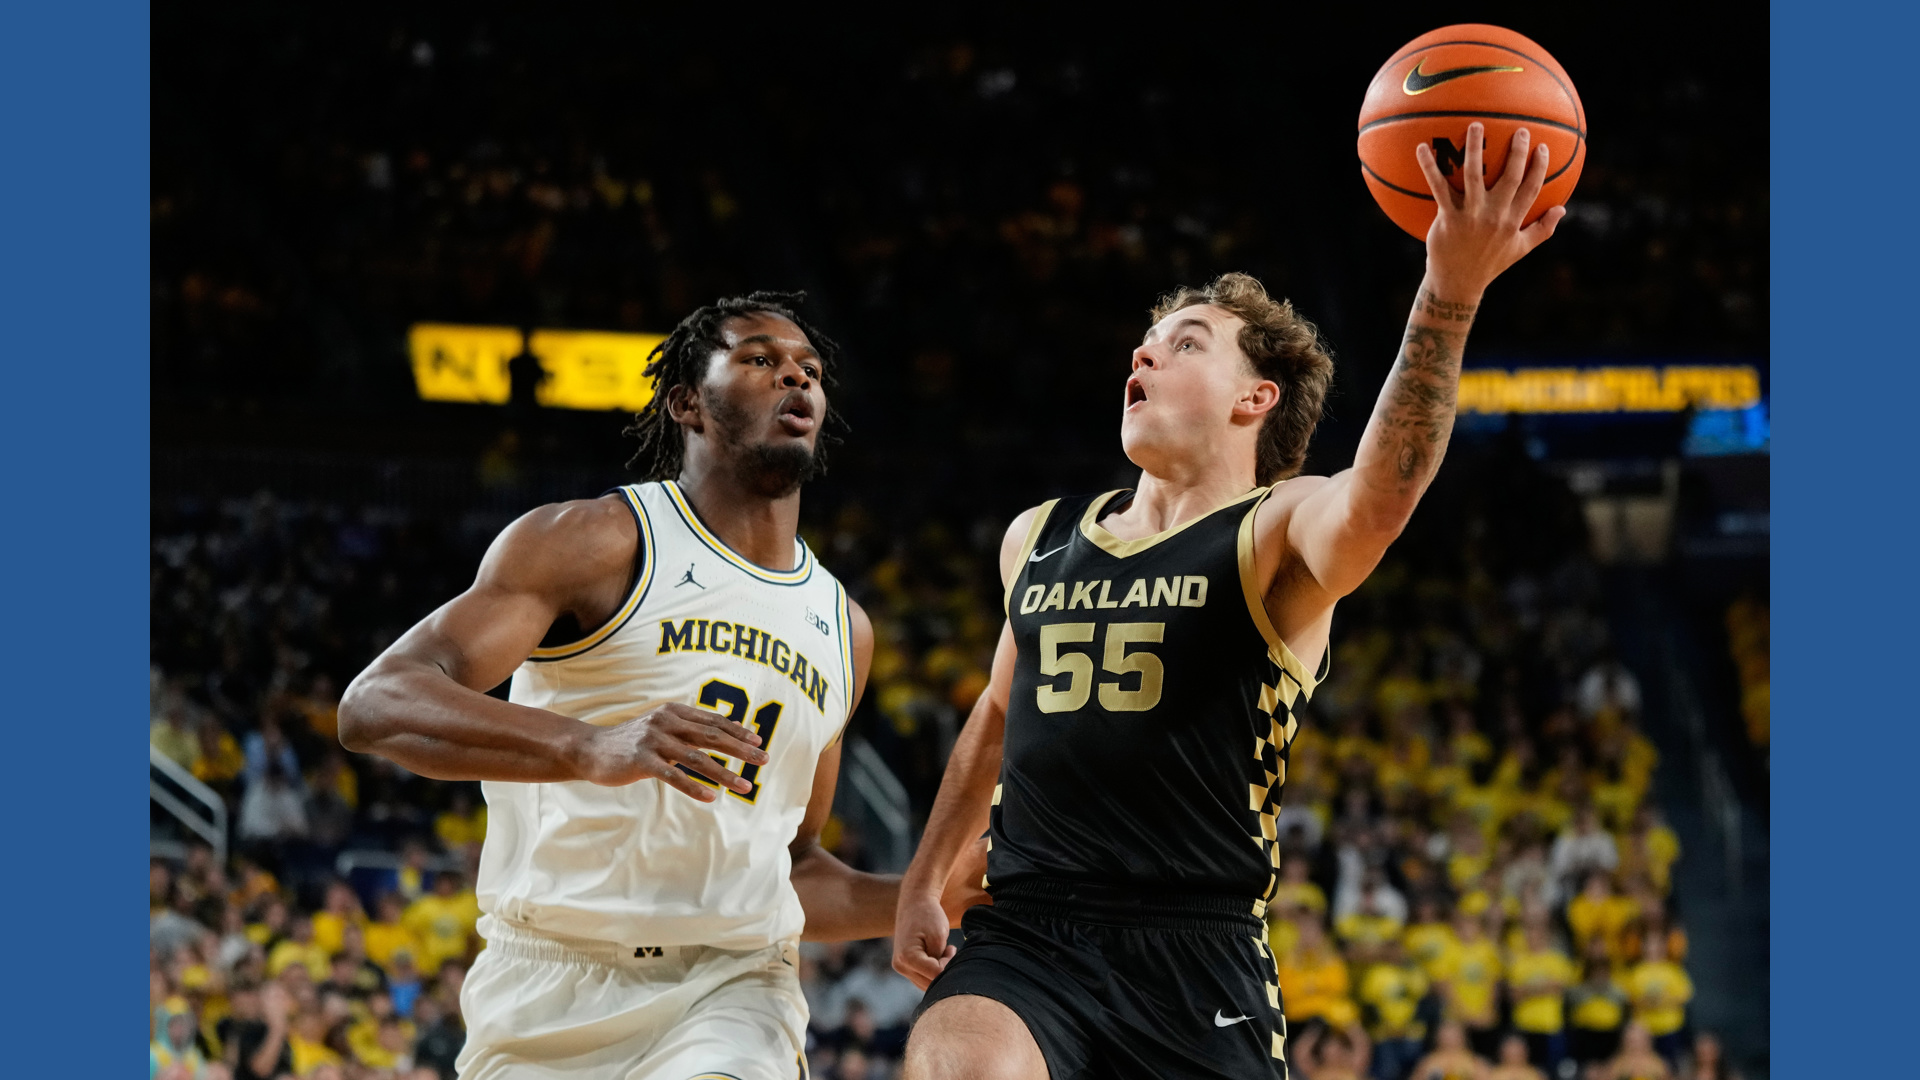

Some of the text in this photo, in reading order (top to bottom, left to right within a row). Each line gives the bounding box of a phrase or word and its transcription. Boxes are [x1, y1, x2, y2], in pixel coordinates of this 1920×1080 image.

[1432, 137, 1486, 176] M
[1020, 575, 1209, 615] OAKLAND
[656, 618, 829, 716] MICHIGAN
[1036, 622, 1166, 714] 55
